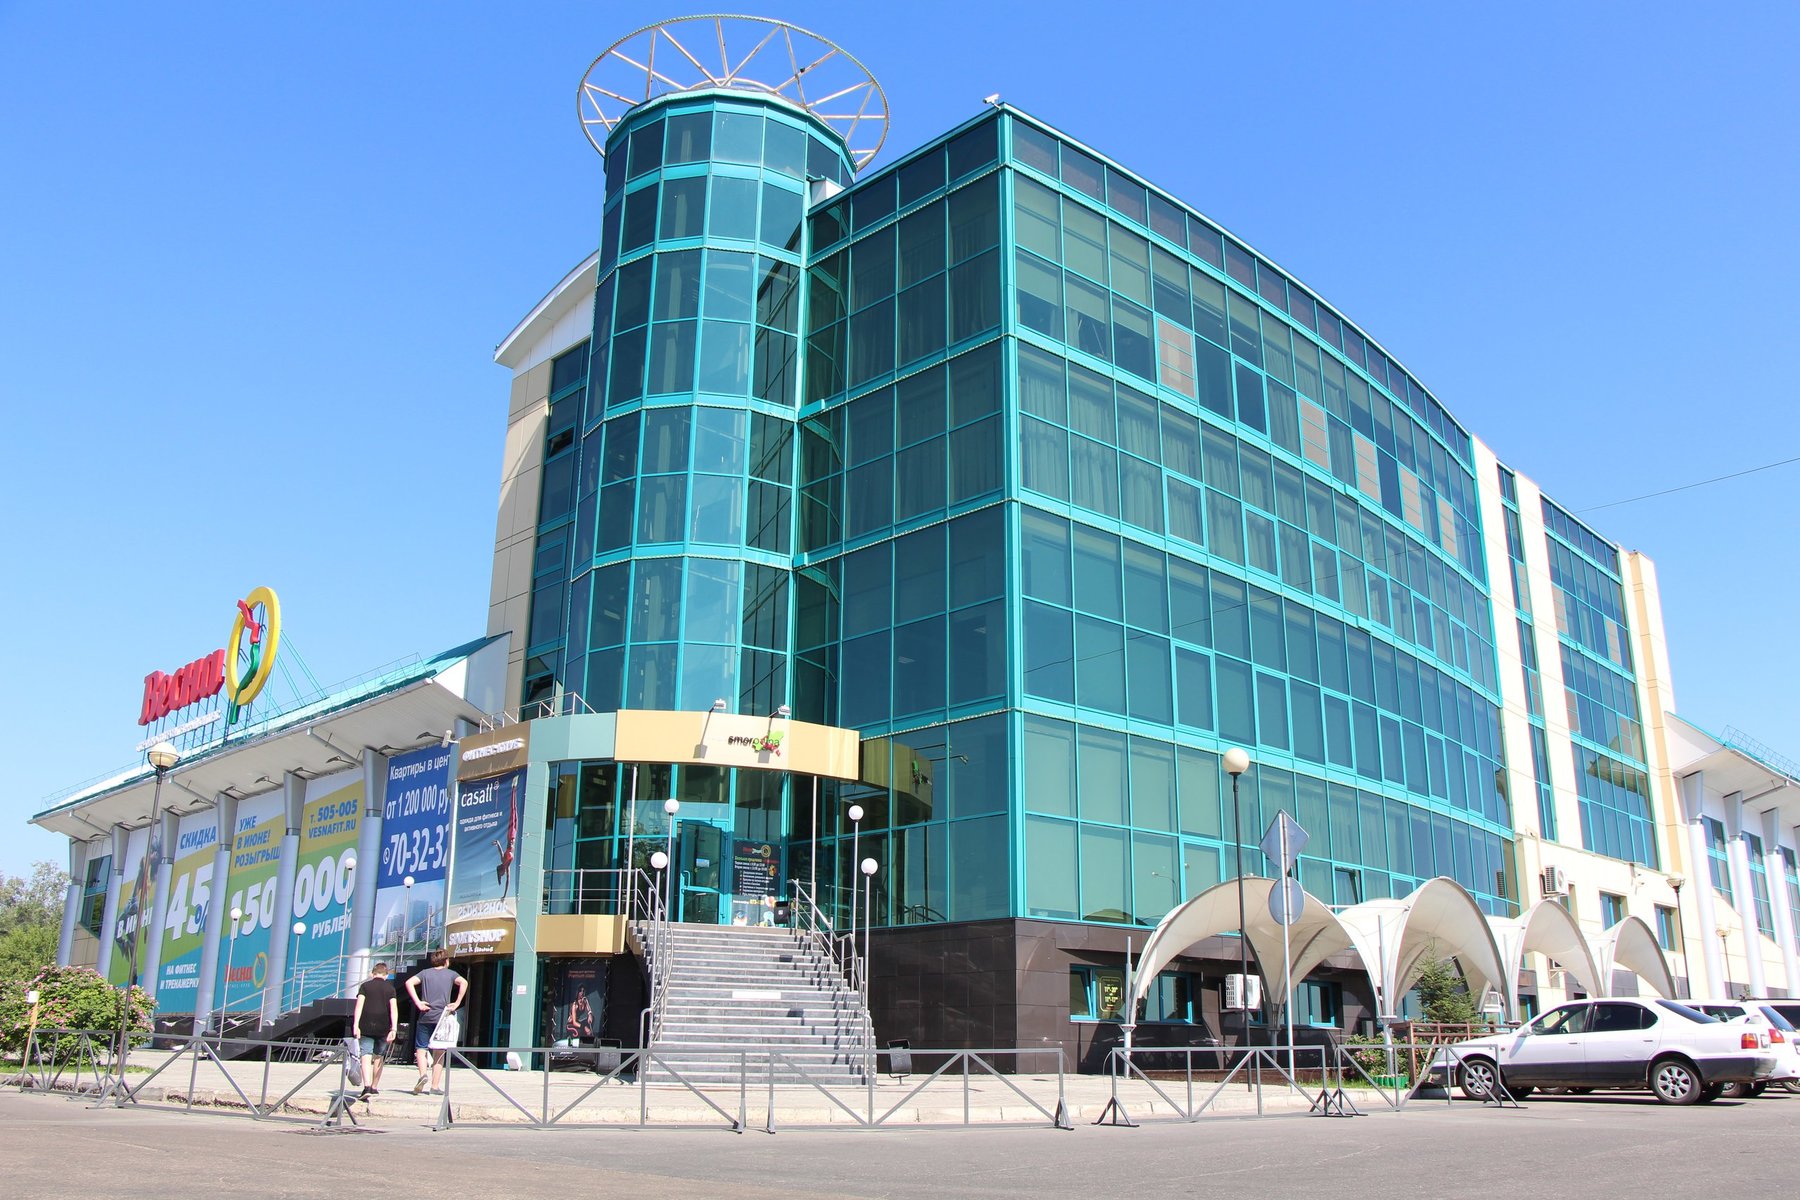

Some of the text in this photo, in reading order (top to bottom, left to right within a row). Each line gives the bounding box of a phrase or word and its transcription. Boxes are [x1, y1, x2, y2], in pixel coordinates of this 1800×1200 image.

[390, 761, 426, 781] Квартиры
[427, 760, 432, 770] в
[386, 800, 396, 820] от
[398, 792, 403, 817] 1
[404, 788, 420, 817] 200
[421, 784, 437, 813] 000
[461, 783, 493, 808] casall
[317, 799, 358, 822] 505-005
[239, 815, 257, 832] УЖЕ
[308, 819, 357, 838] VESNAFIT.RU
[180, 826, 217, 850] СКИДКА
[236, 829, 271, 849] В ИЮНЕ!
[293, 848, 358, 918] 000
[116, 919, 124, 939] В
[312, 907, 352, 940] РУБЛЕЙ
[166, 963, 197, 975] НА ФИТНЕС
[160, 980, 165, 990] И
